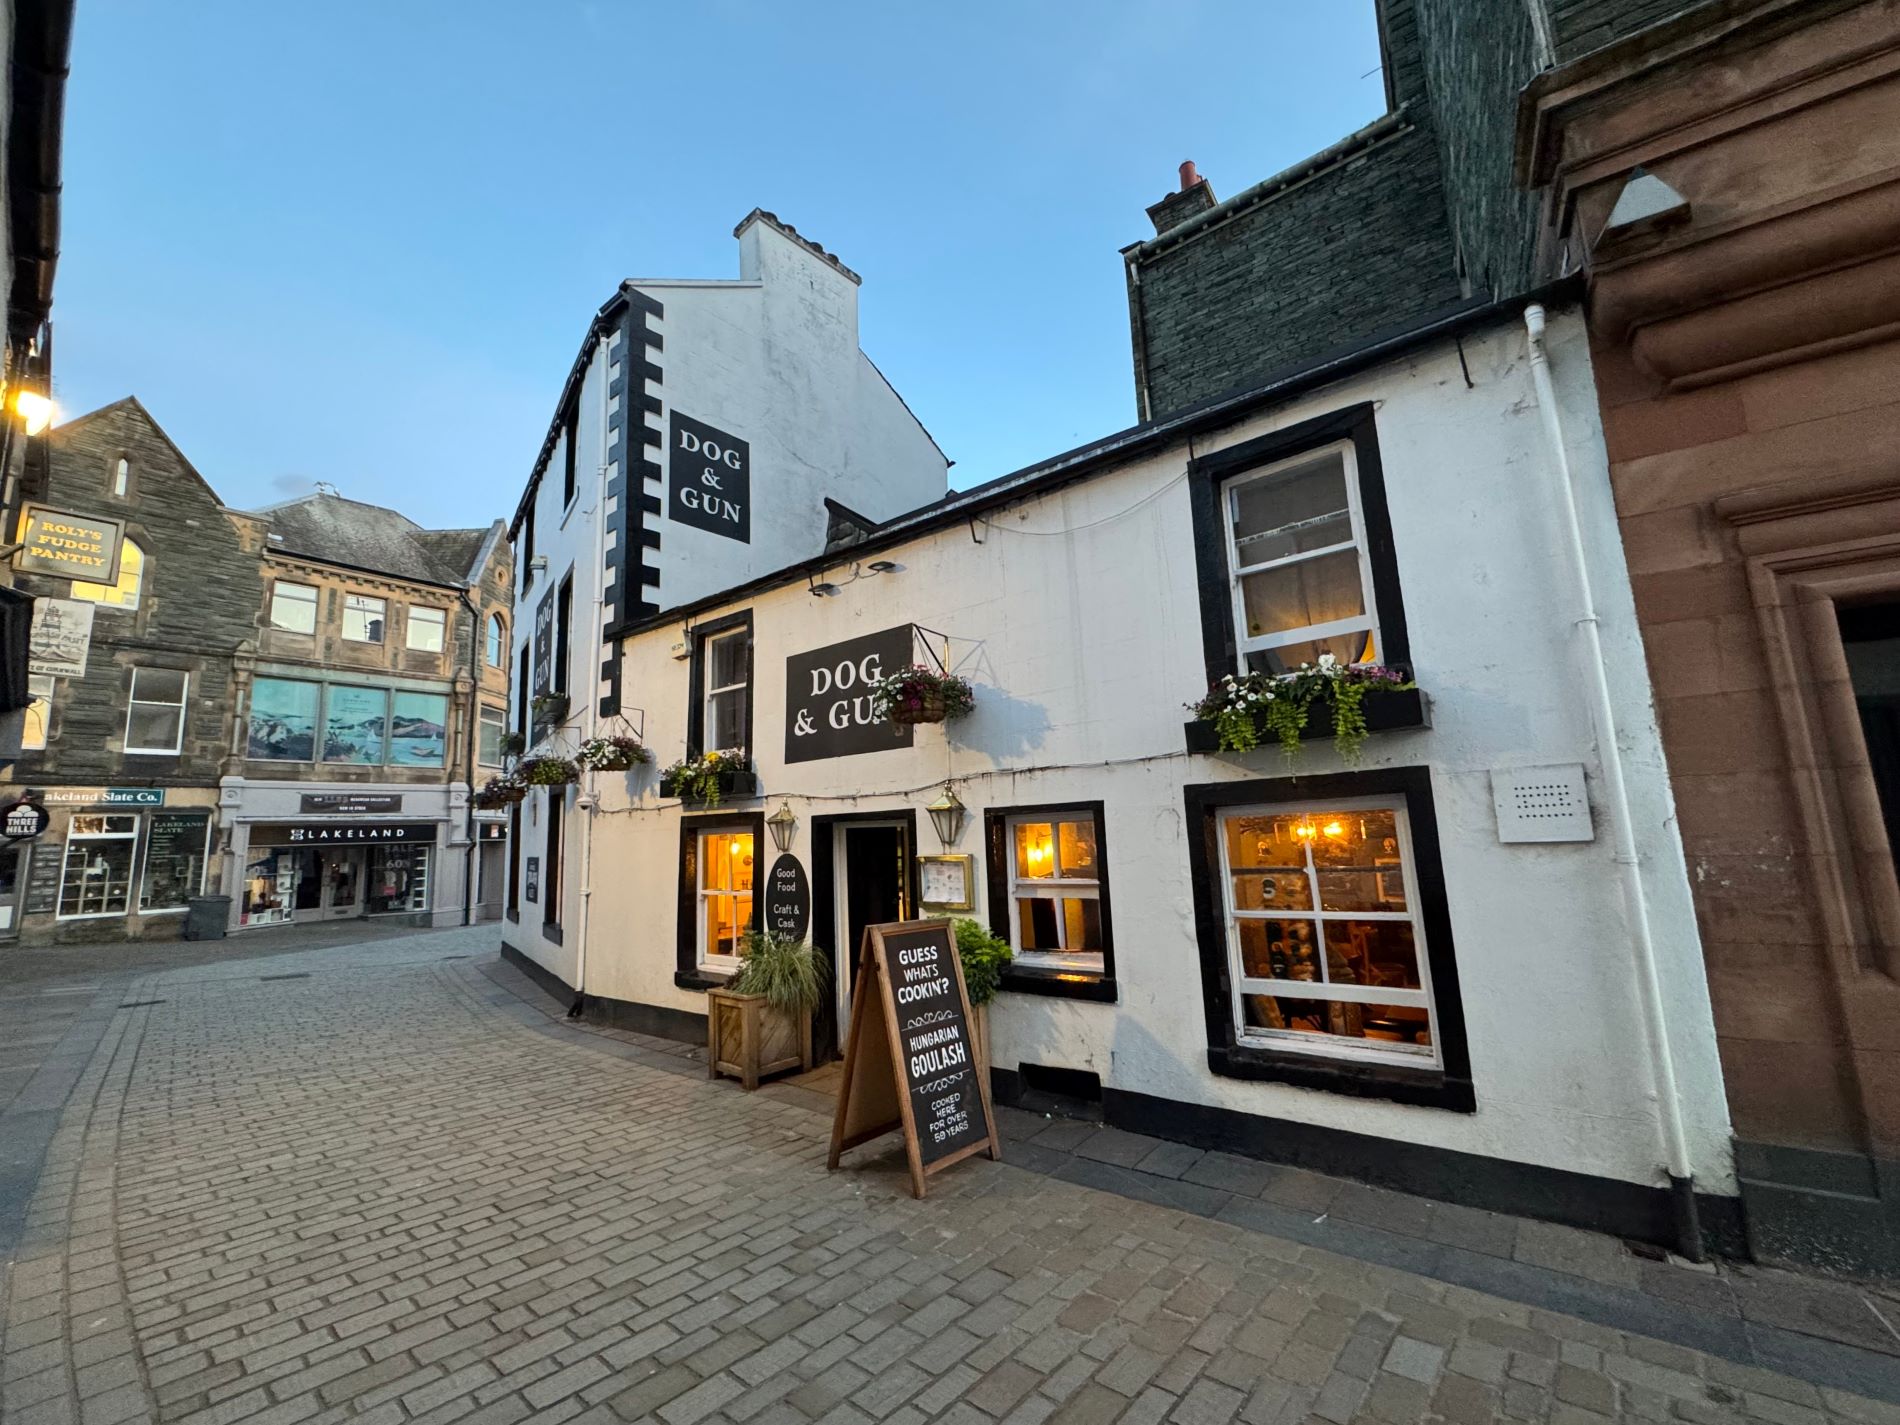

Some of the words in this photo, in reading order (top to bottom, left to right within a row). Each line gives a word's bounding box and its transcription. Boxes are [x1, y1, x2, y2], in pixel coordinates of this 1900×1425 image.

[679, 428, 742, 470] DOG
[701, 467, 723, 490] &
[679, 486, 742, 523] GUN
[41, 521, 103, 541] ROLY'S
[37, 534, 102, 553] FUDGE
[30, 546, 106, 566] PANTRY
[537, 598, 553, 637] DOG
[535, 655, 551, 691] GUN
[809, 653, 885, 697] DOG
[794, 708, 818, 737] &
[828, 692, 888, 730] GU
[44, 791, 98, 801] akeland
[102, 791, 134, 802] Slate
[136, 792, 158, 802] Co.
[5, 825, 37, 834] HILLS
[7, 817, 39, 826] THREE
[308, 828, 405, 839] LAKELAND
[776, 868, 796, 878] Good
[777, 881, 796, 892] Food
[773, 904, 792, 915] Craft
[793, 904, 800, 915] &
[777, 918, 796, 929] Cask
[777, 931, 795, 943] Ales
[898, 945, 939, 966] GUESS
[897, 977, 950, 1005] COOKIN'?
[909, 1026, 959, 1052] HUNGARIAN
[911, 1042, 966, 1079] GOULASH
[931, 1092, 961, 1111] COOKED
[936, 1103, 957, 1119] HERE
[929, 1119, 945, 1132] FOR
[946, 1110, 968, 1125] OVER
[945, 1120, 969, 1138] YEARS
